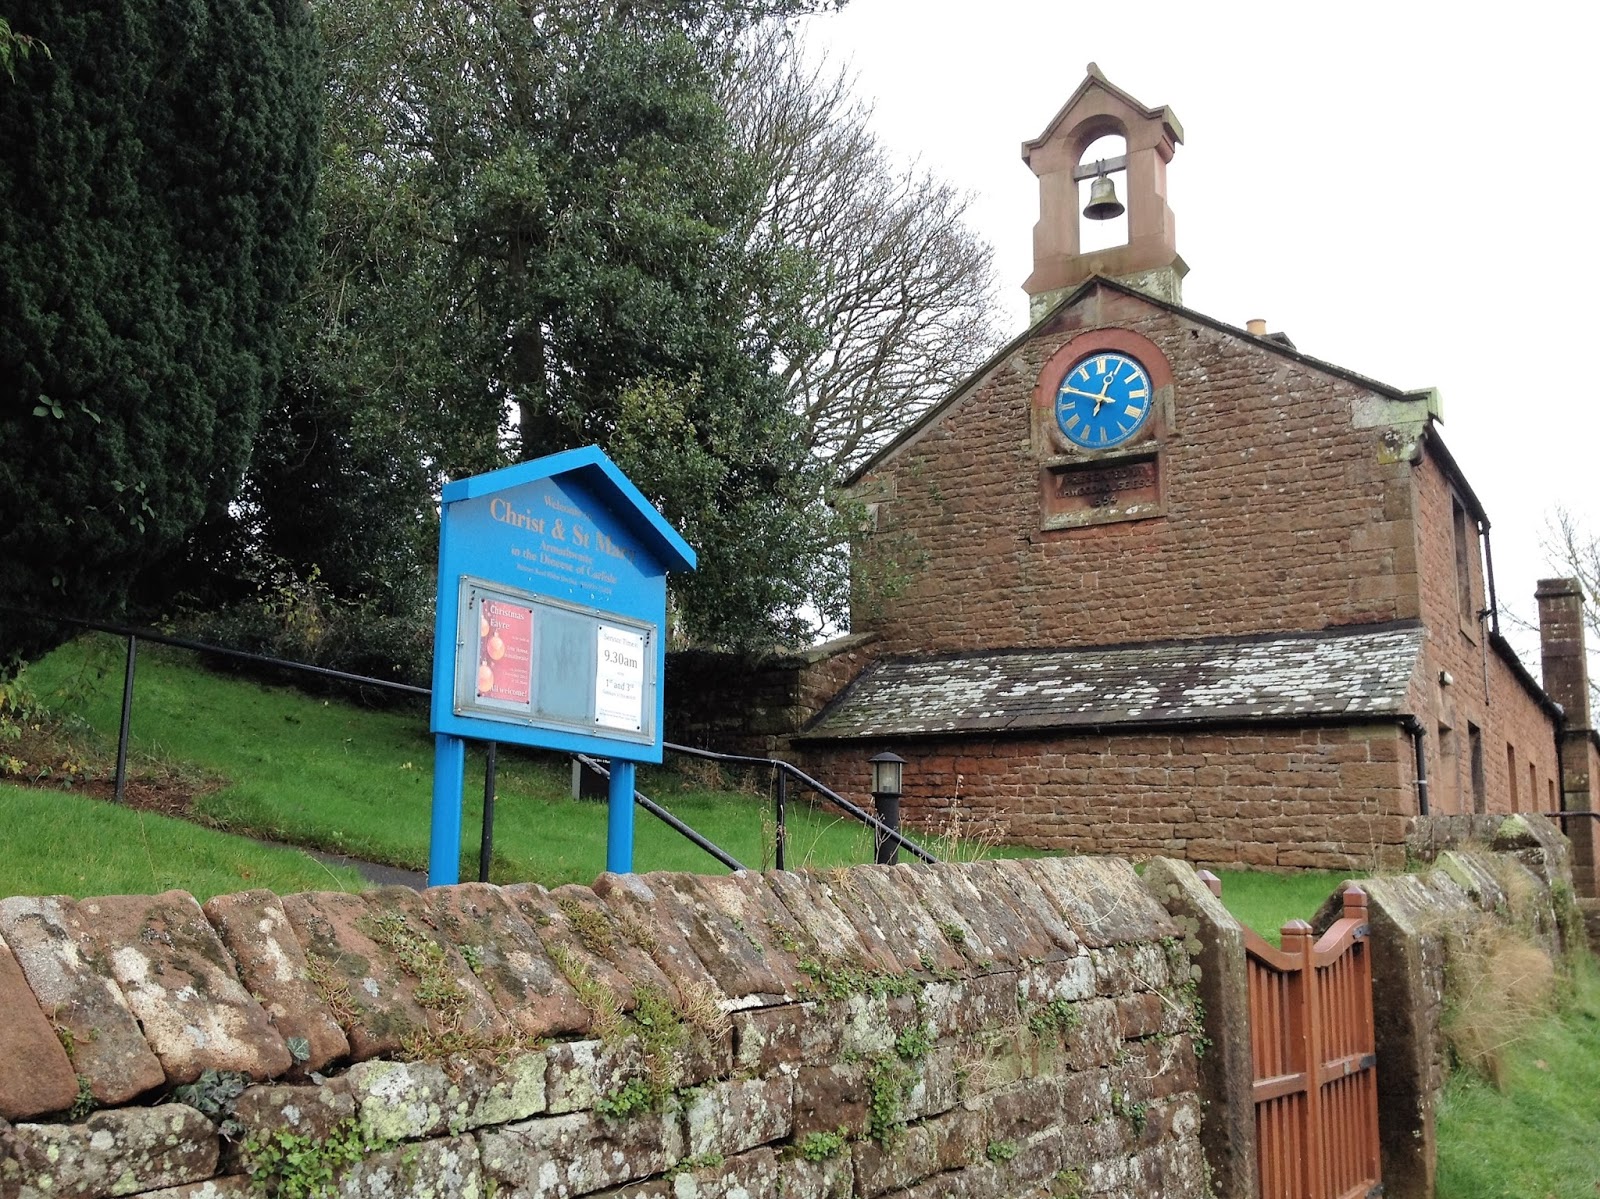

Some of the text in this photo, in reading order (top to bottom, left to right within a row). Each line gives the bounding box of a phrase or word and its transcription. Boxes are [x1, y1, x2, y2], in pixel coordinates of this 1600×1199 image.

[490, 498, 546, 535] Christ
[551, 517, 566, 541] &
[572, 523, 591, 549] St
[524, 547, 537, 561] the
[576, 564, 586, 576] of
[490, 604, 525, 621] Christmas
[490, 617, 510, 631] Fayre
[603, 649, 638, 669] 9.30am
[498, 686, 528, 698] welcome!
[613, 682, 625, 691] and
